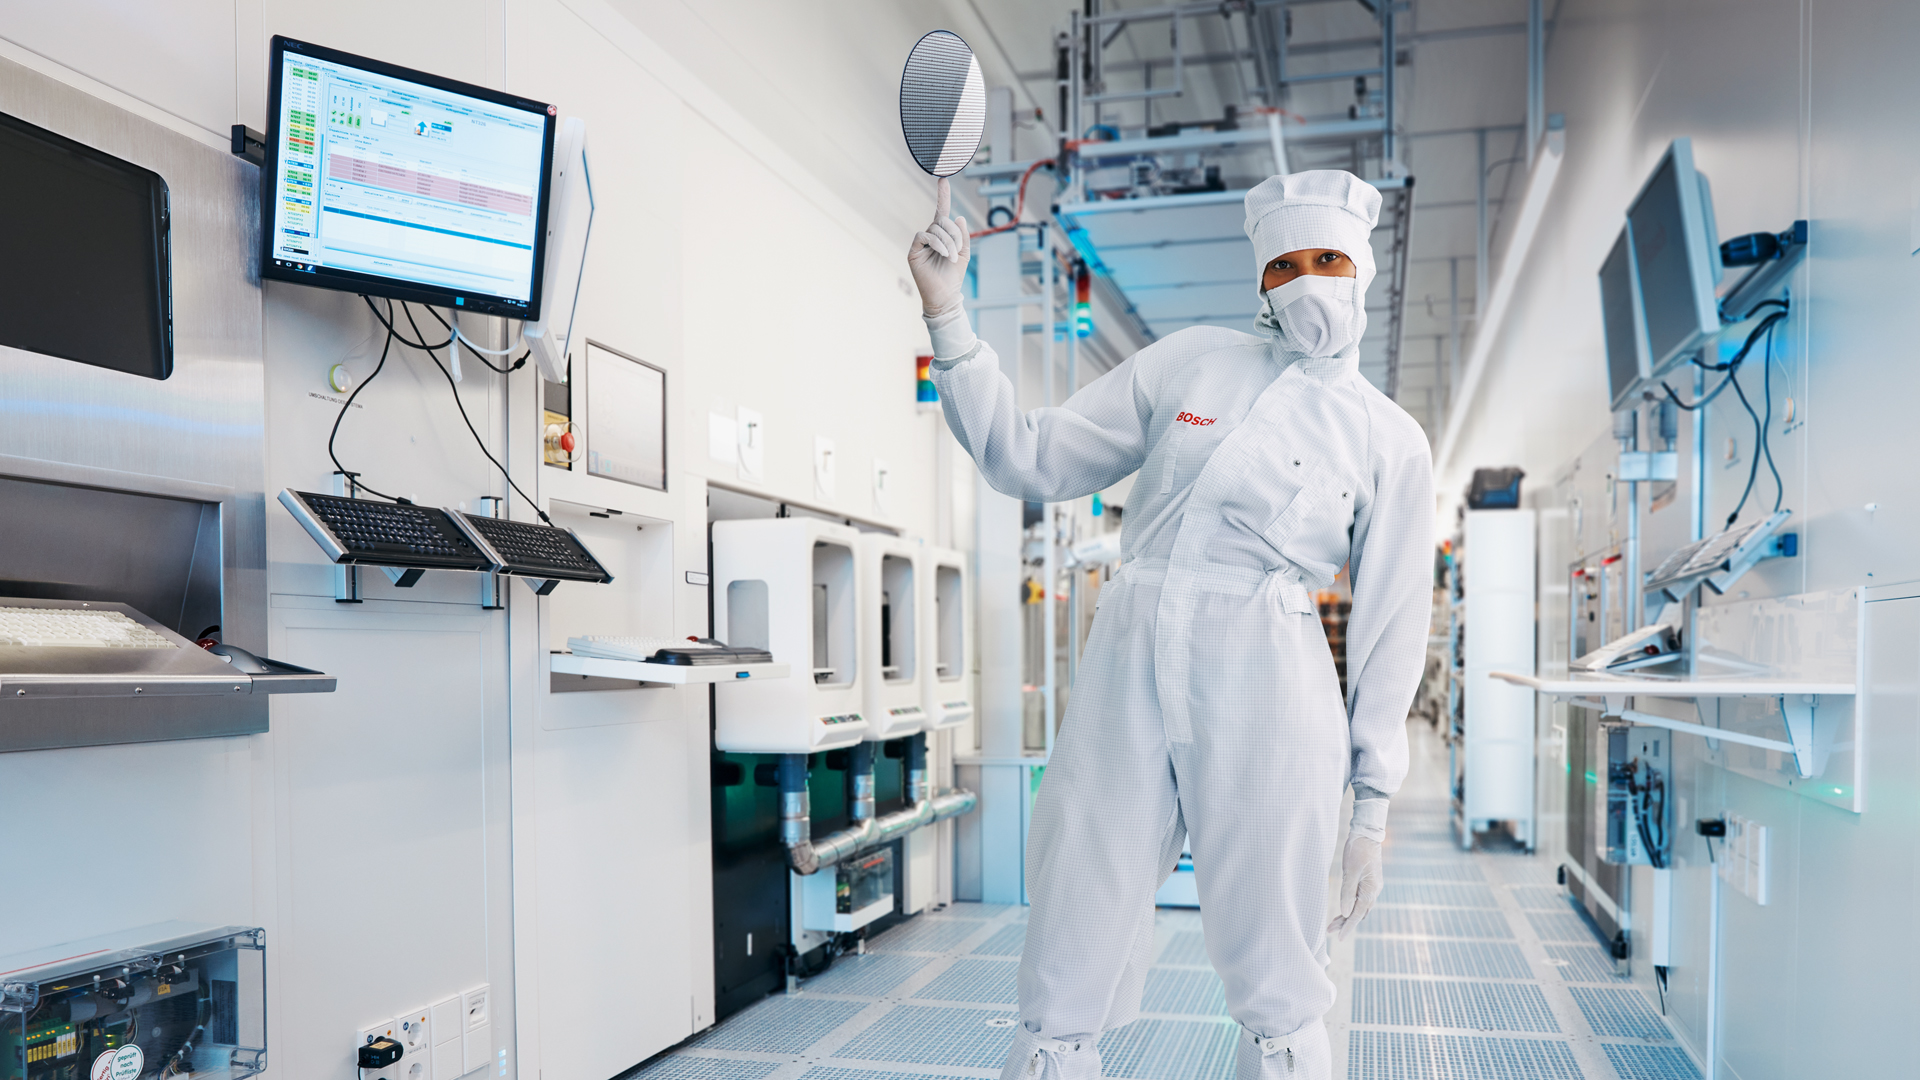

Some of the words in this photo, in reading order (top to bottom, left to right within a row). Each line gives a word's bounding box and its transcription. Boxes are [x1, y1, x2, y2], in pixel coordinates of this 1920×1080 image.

[283, 40, 303, 50] NEC
[471, 119, 486, 127] NT326
[308, 392, 338, 403] UMSCHALTUNG
[1176, 411, 1218, 426] BOSCH
[117, 1052, 137, 1062] geprüft
[120, 1060, 133, 1068] nach
[116, 1068, 137, 1077] Prüfliste
